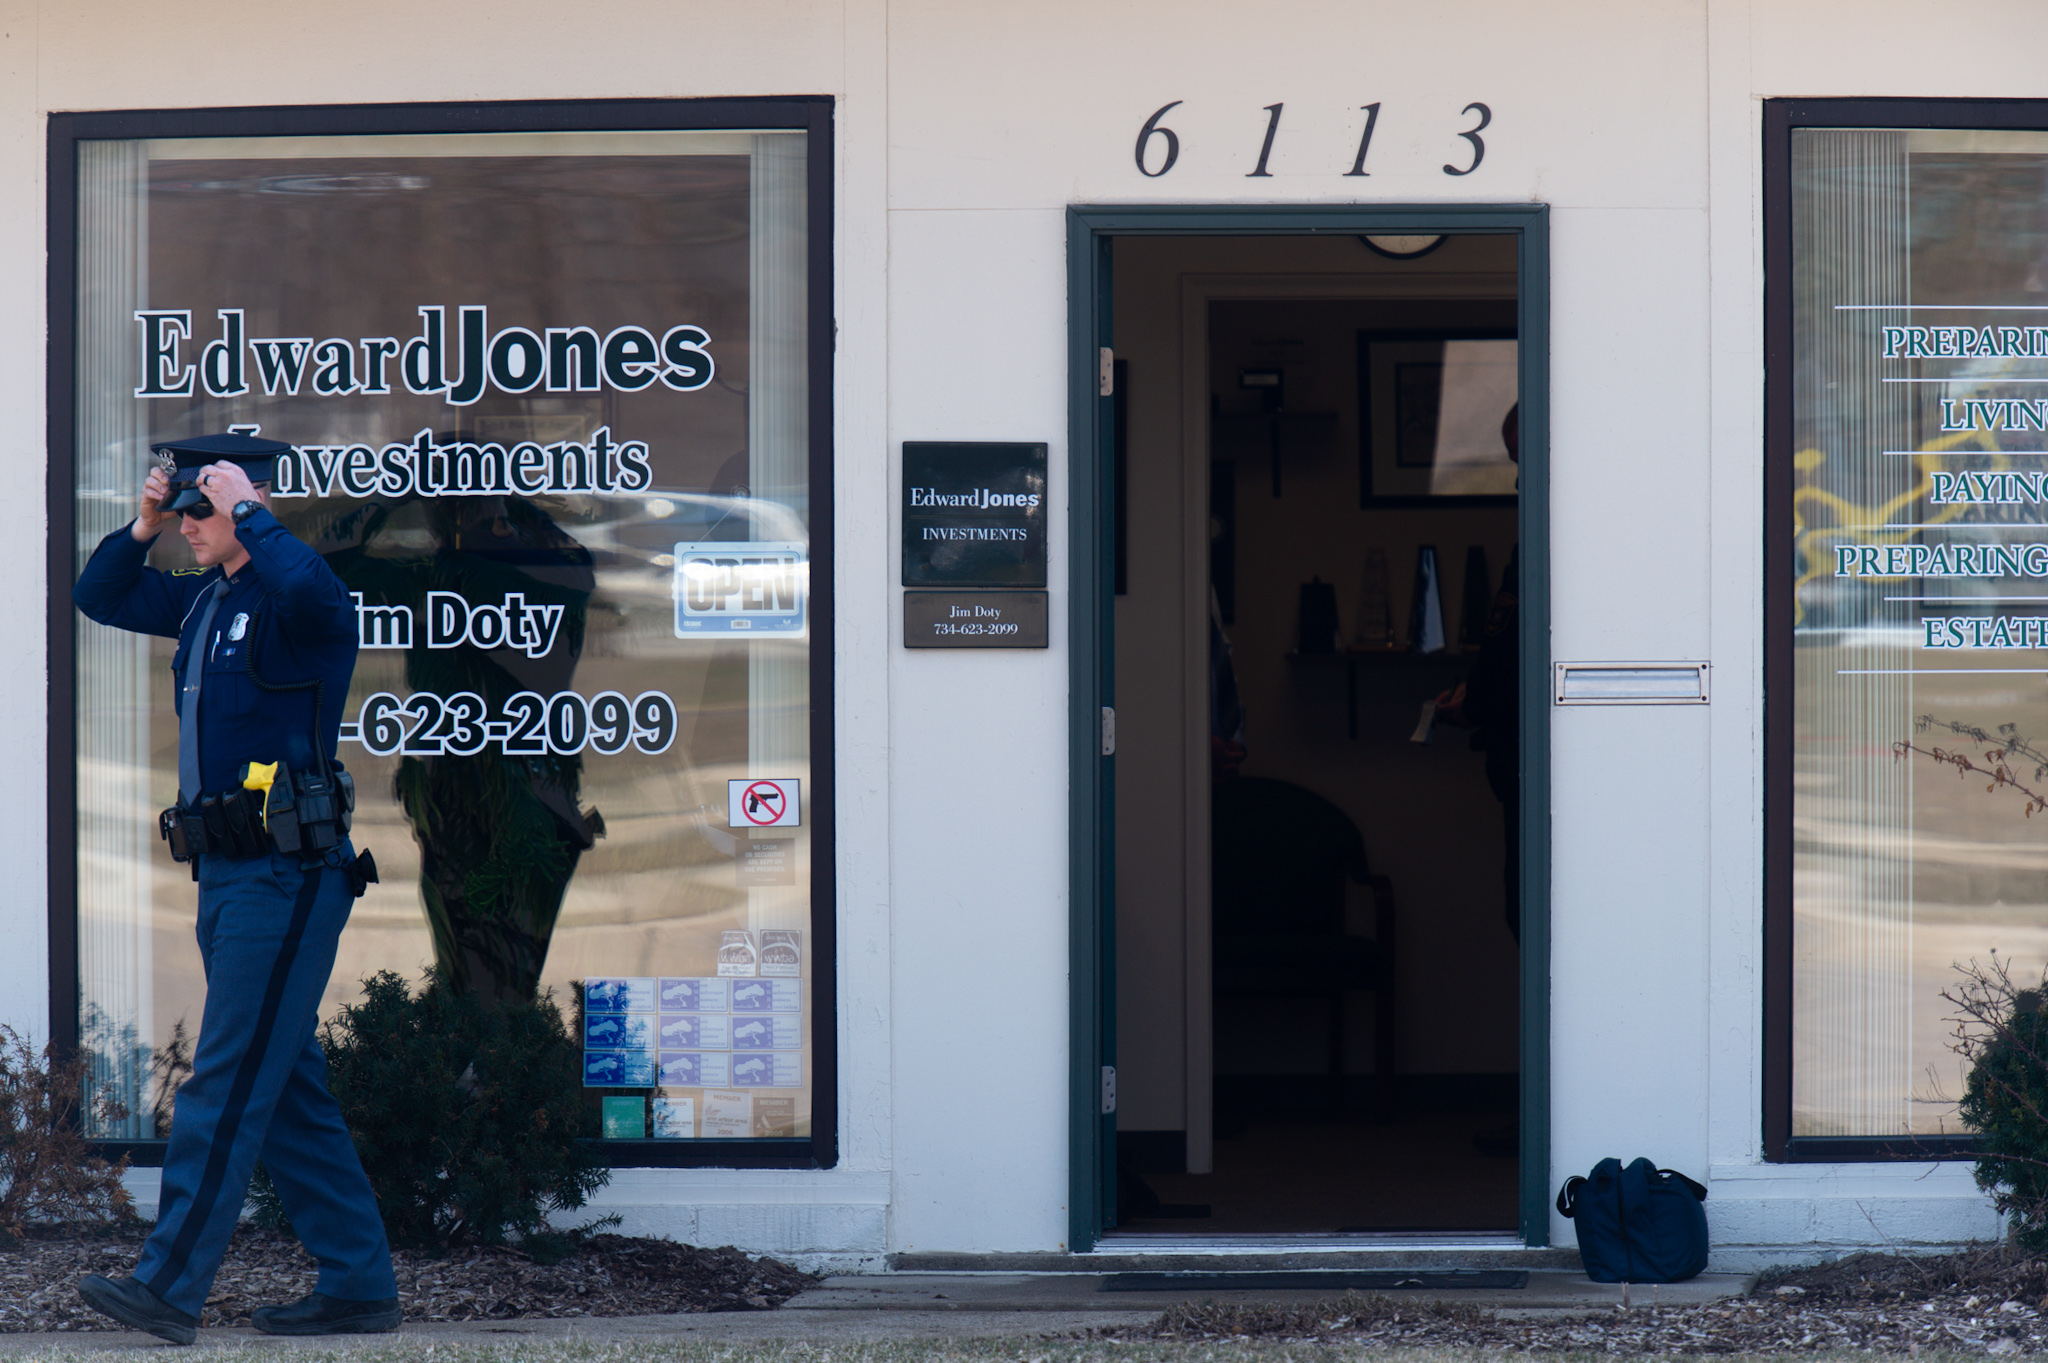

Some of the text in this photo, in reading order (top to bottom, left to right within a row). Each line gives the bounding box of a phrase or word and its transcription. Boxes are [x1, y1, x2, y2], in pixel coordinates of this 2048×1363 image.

[1134, 100, 1493, 178] 6113
[133, 304, 717, 406] EdwardJones
[1940, 399, 2048, 431] LIVIN
[227, 423, 653, 499] nvestments
[1930, 470, 2048, 504] PAYIN
[922, 528, 1027, 541] INVESTMENTS
[1836, 543, 2048, 577] PREPARING
[688, 557, 795, 611] OPEN
[427, 591, 565, 658] Doty
[934, 623, 1018, 635] 734-623-2099
[950, 605, 1001, 620] Jim Doty
[713, 1094, 742, 1102] MEMBER
